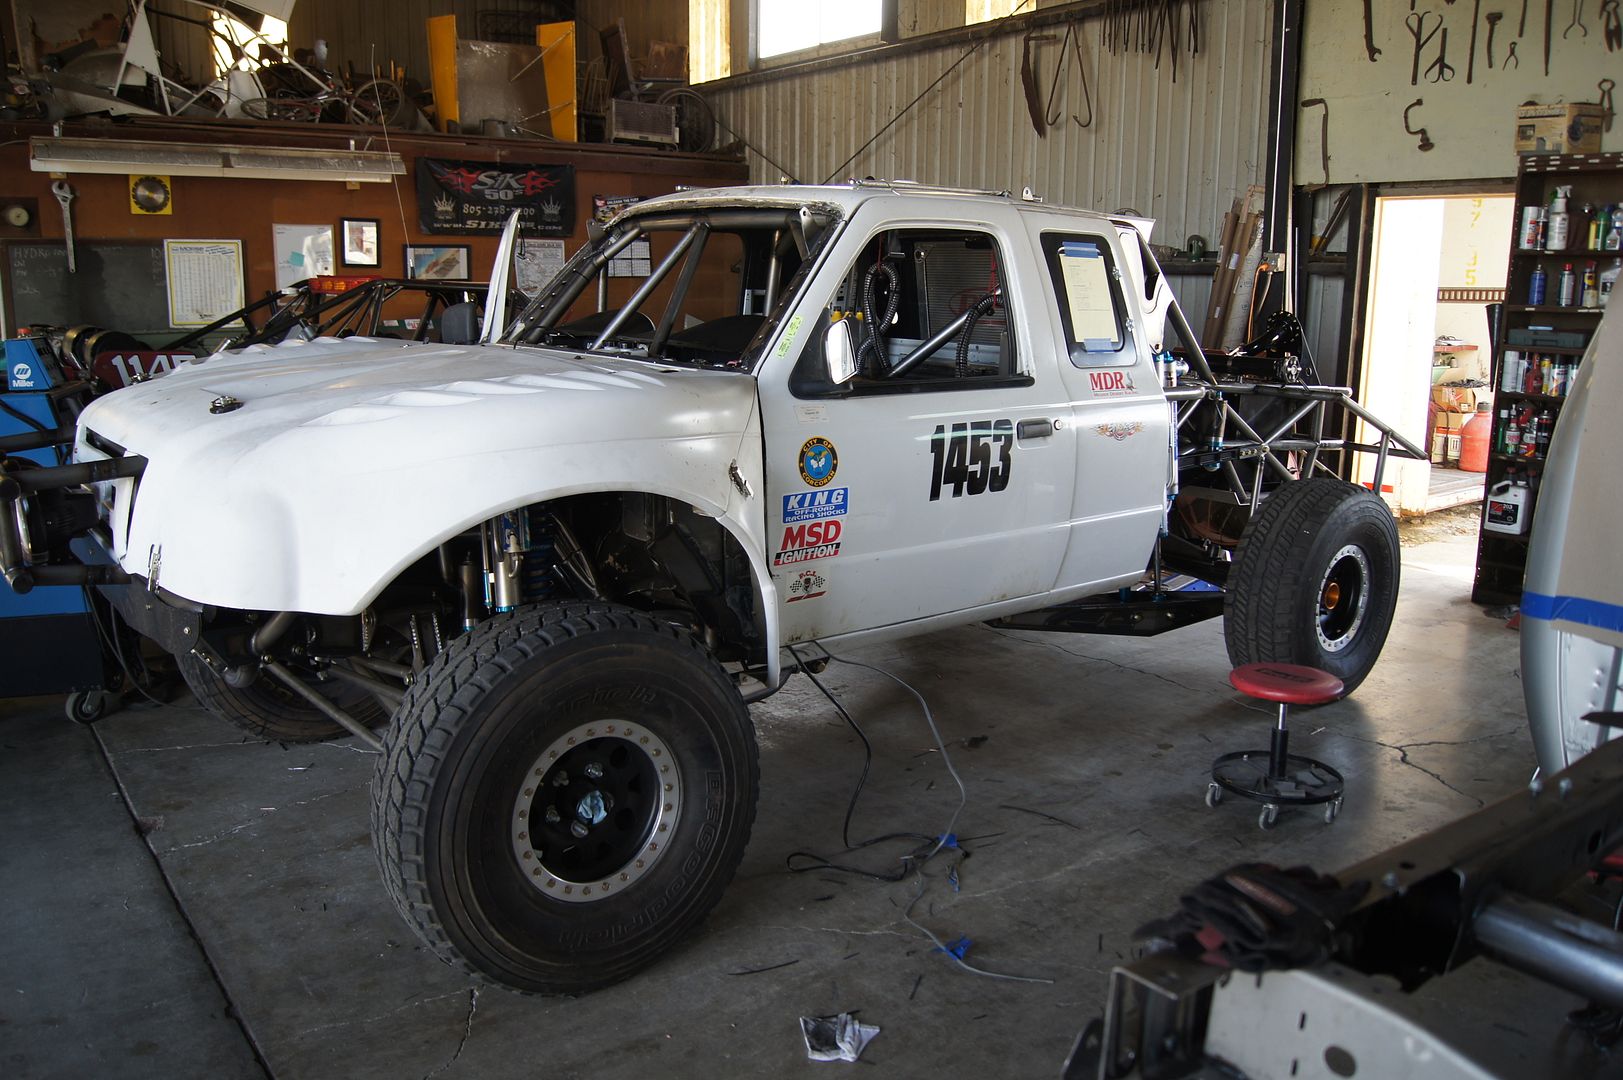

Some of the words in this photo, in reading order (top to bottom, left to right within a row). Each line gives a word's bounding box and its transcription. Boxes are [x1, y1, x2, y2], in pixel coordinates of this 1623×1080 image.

[12, 379, 34, 388] Miller
[1089, 371, 1125, 390] MDR
[803, 438, 818, 452] CITY
[823, 440, 833, 449] OF
[929, 419, 1013, 501] 1453
[802, 470, 835, 487] CORCORAN
[787, 489, 845, 510] KING
[785, 513, 815, 523] RACING
[816, 508, 845, 518] SHOCKS
[794, 505, 835, 515] OFF-ROAD
[780, 520, 842, 551] MSD
[779, 544, 837, 565] IGNITION
